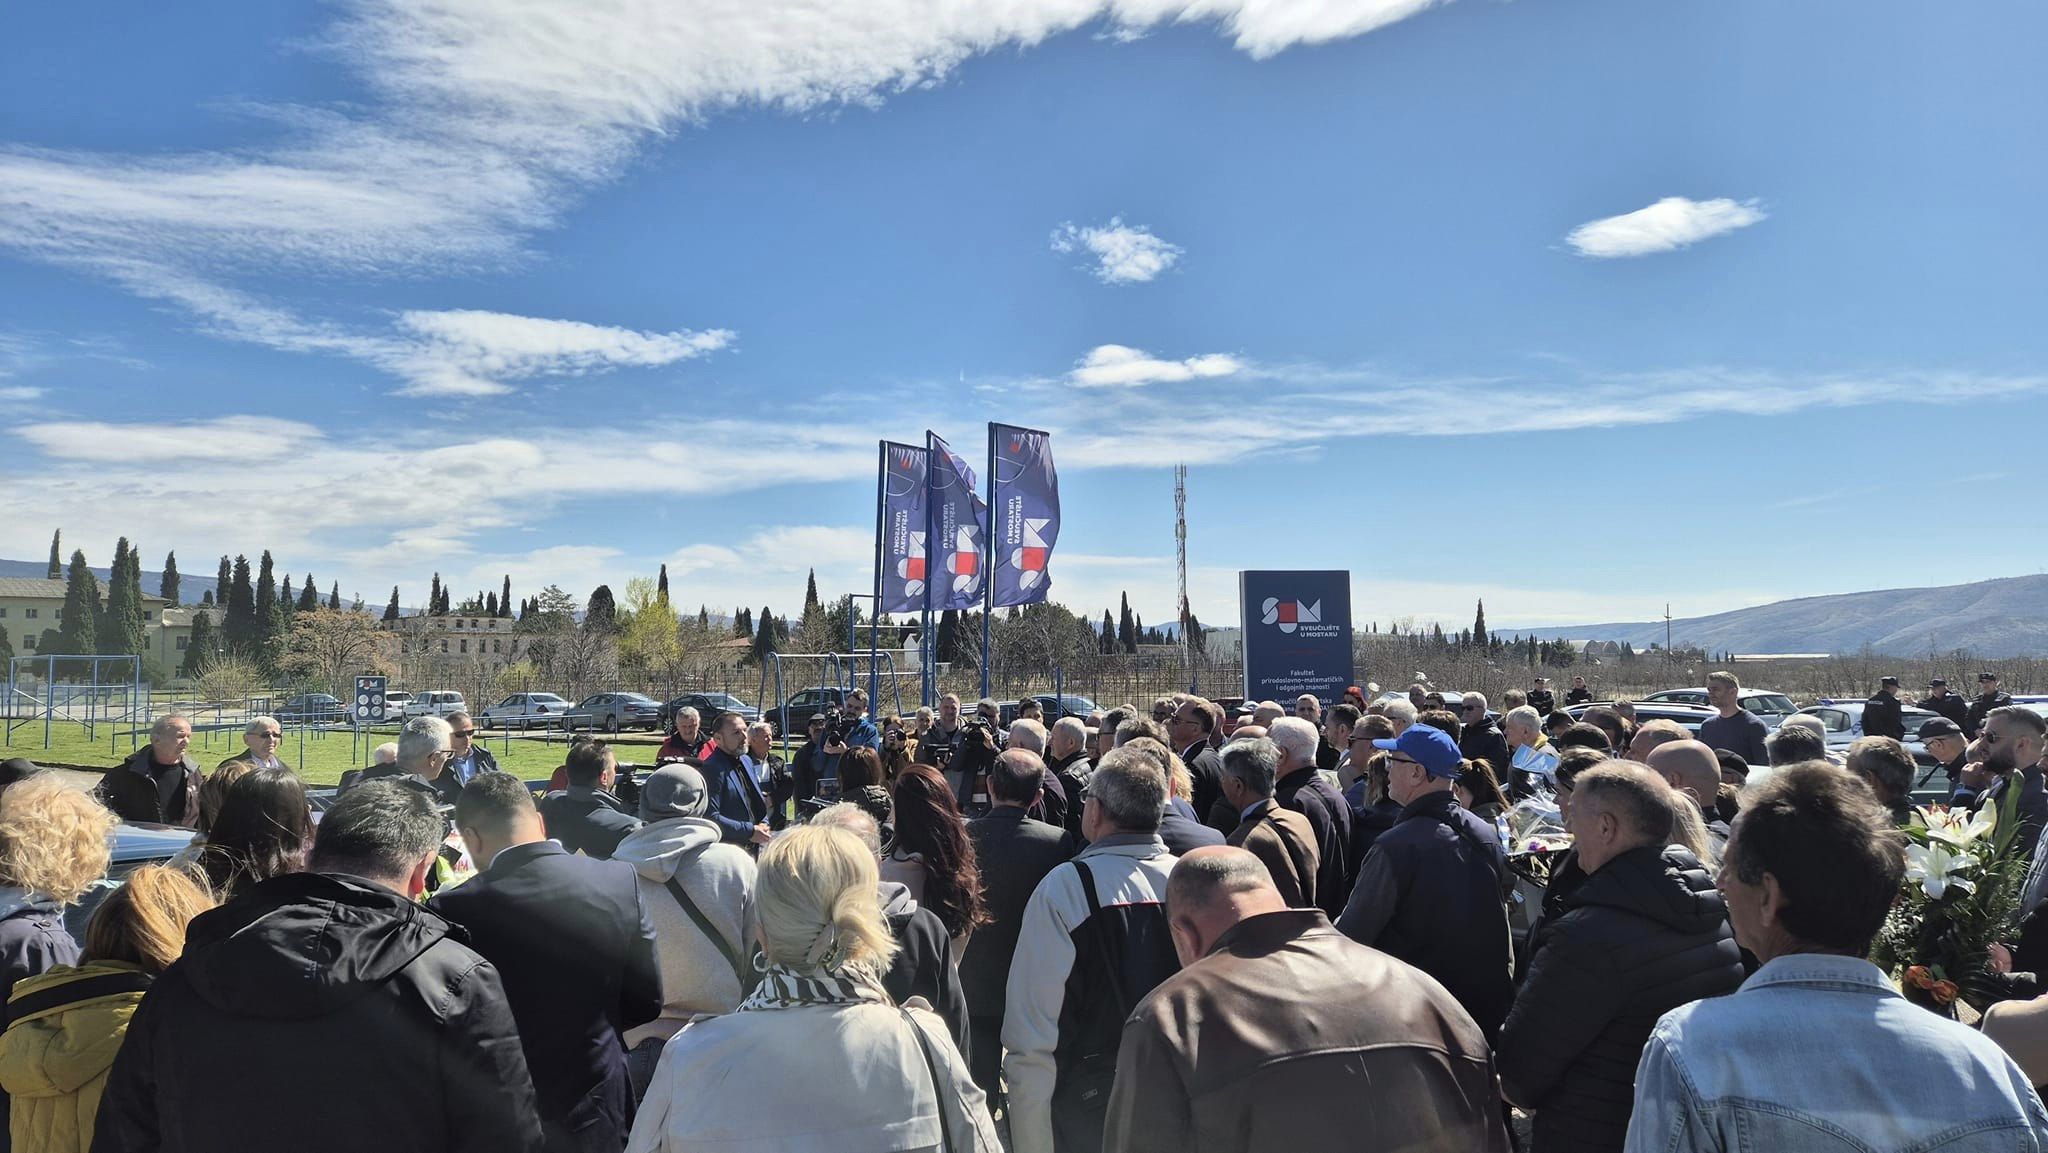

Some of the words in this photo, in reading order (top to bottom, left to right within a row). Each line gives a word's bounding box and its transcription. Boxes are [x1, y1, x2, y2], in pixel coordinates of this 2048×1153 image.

[1261, 597, 1321, 633] SUM
[1261, 675, 1344, 685] prirodoslovno-matematičkih
[1279, 684, 1305, 692] odgojnih
